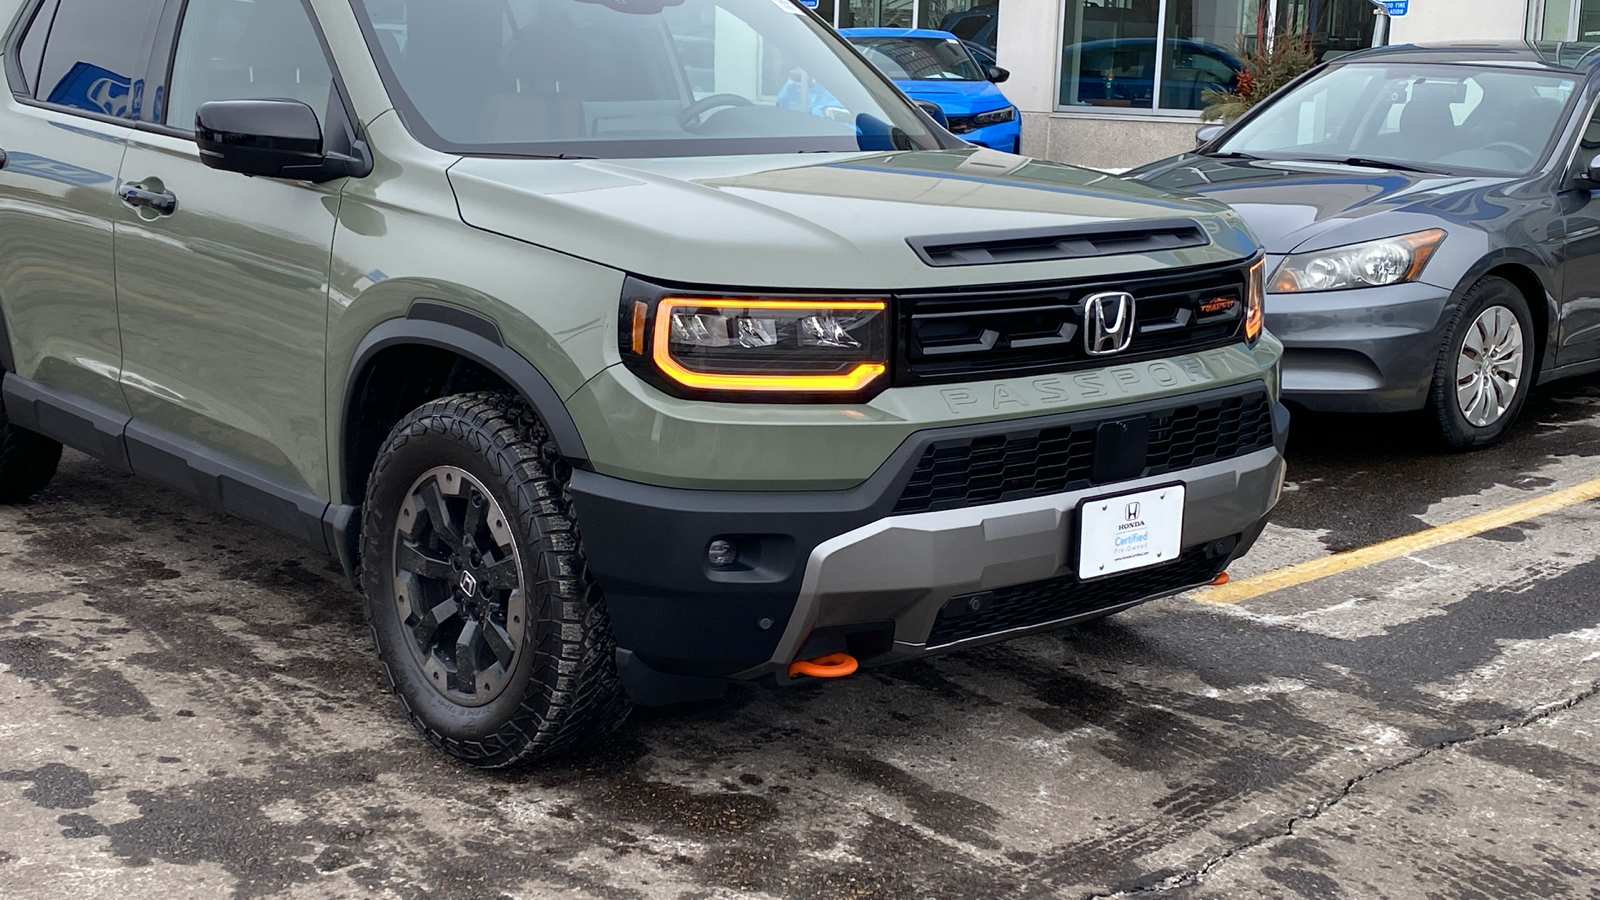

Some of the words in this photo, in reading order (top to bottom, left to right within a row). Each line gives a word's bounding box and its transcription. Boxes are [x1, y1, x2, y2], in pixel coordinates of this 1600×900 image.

[939, 351, 1231, 414] PASSPORT
[1118, 520, 1145, 531] HONDA
[1114, 531, 1148, 546] Certified
[1114, 543, 1148, 554] Pre-Owned
